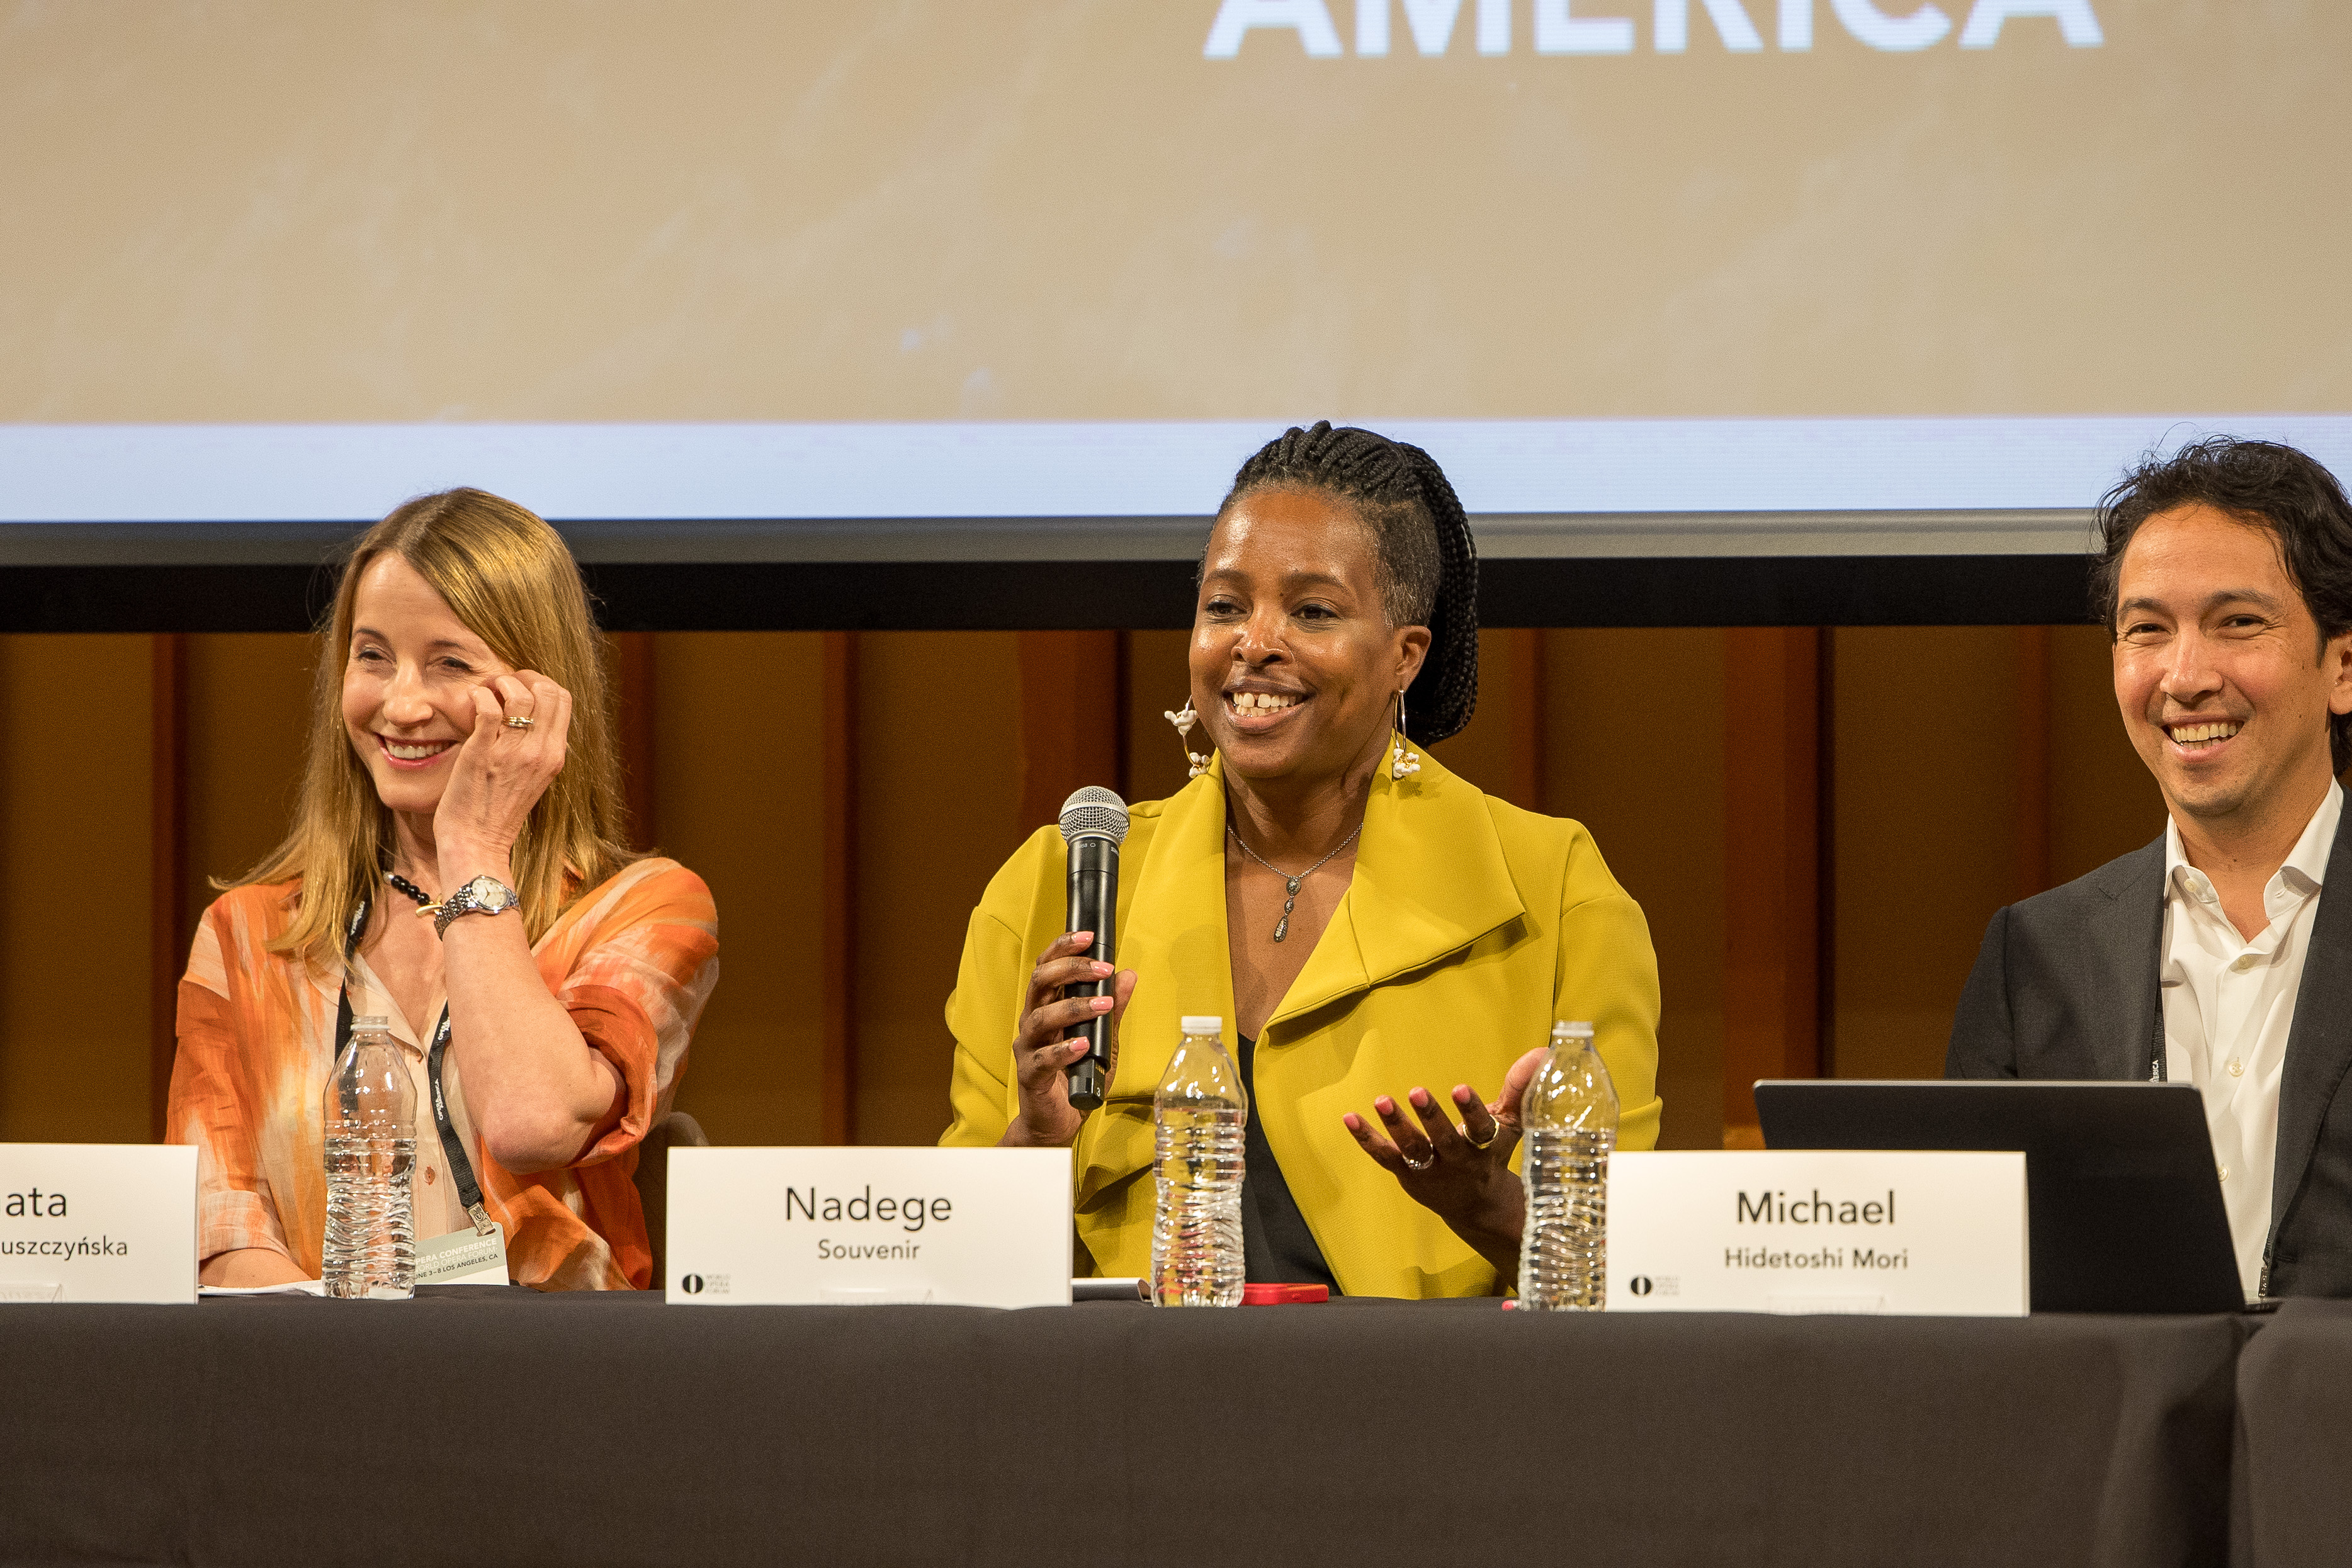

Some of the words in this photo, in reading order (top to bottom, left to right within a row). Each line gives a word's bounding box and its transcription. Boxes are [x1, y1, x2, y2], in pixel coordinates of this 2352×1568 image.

[6, 1187, 67, 1217] ata
[786, 1185, 952, 1232] Nadege
[1738, 1188, 1895, 1225] Michael
[1, 1234, 127, 1261] uszczyńska
[416, 1254, 438, 1265] PERA
[439, 1238, 497, 1259] CONFERENCE
[441, 1254, 466, 1266] OPERA
[818, 1239, 920, 1260] Souvenir
[1725, 1248, 1843, 1269] Hidetoshi
[1853, 1248, 1908, 1269] Mori
[443, 1264, 455, 1272] LOS
[456, 1256, 488, 1268] ANGELES,
